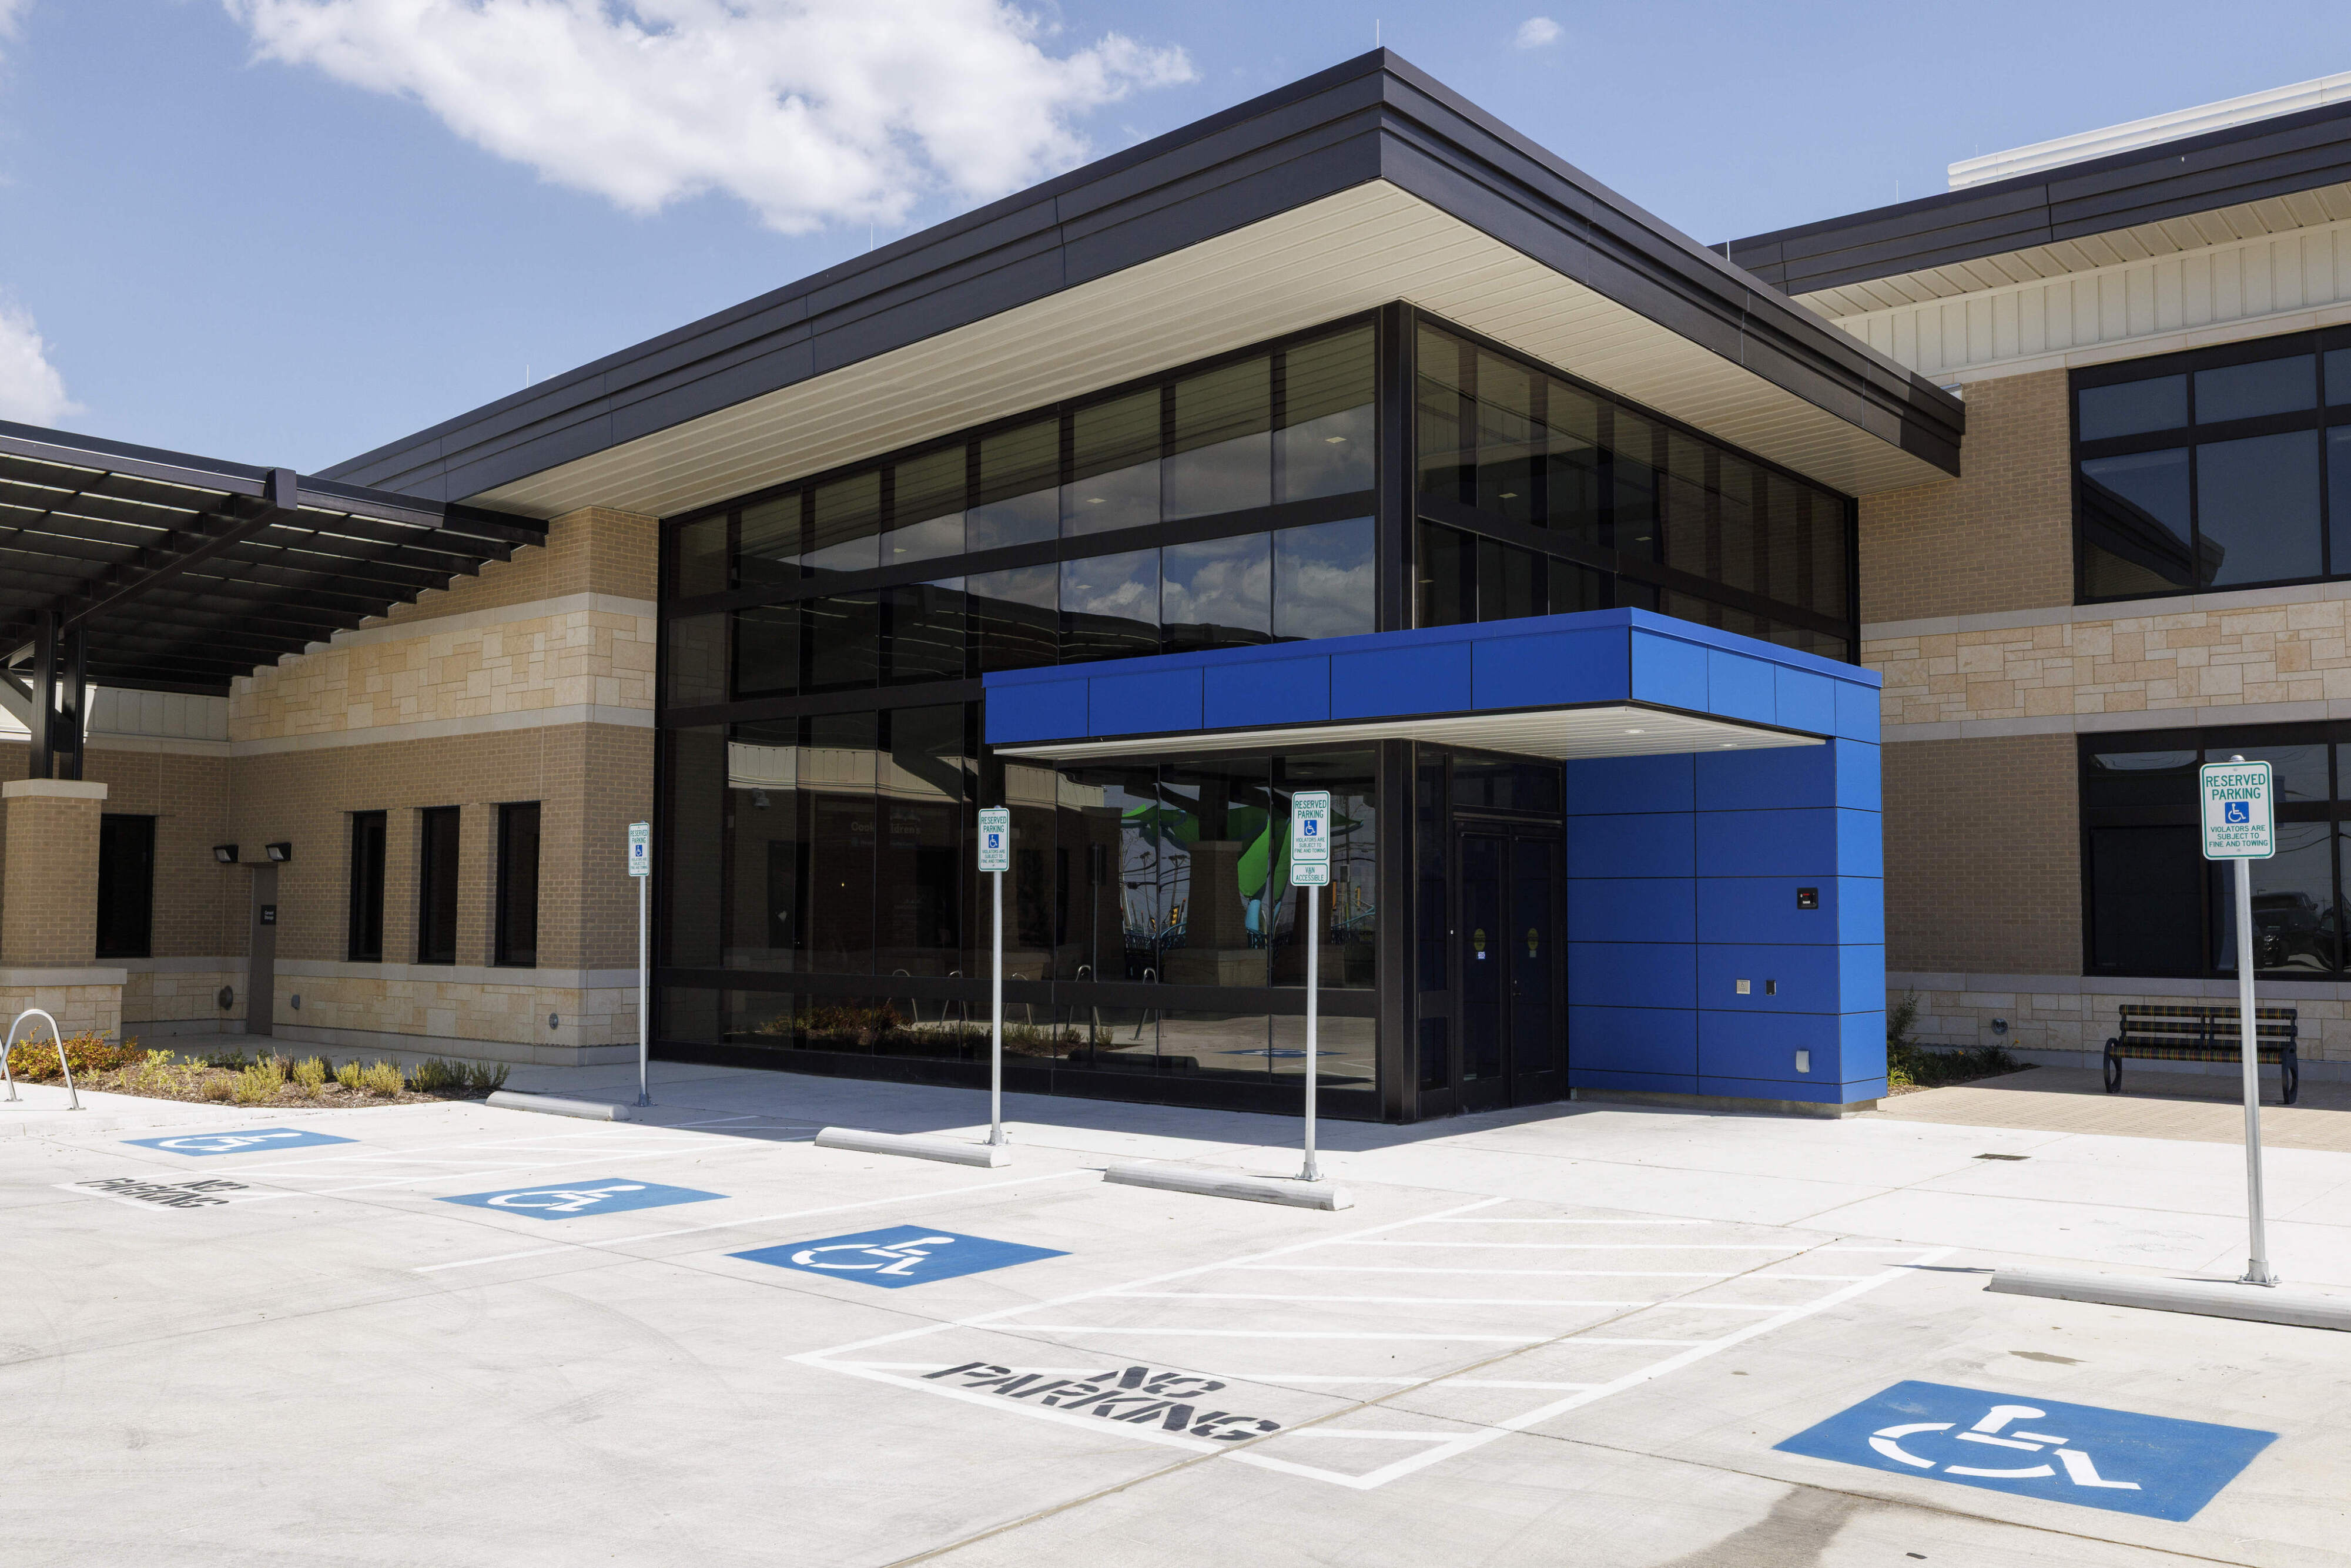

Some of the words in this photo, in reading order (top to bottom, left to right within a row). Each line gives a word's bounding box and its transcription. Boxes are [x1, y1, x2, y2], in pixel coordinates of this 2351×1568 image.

[2206, 773, 2266, 787] RESERVED
[2212, 788, 2261, 800] PARKING
[1295, 799, 1327, 809] RESERVED
[1297, 810, 1324, 819] PARKING
[1086, 1365, 1227, 1399] NO
[920, 1361, 1282, 1441] PARKING
